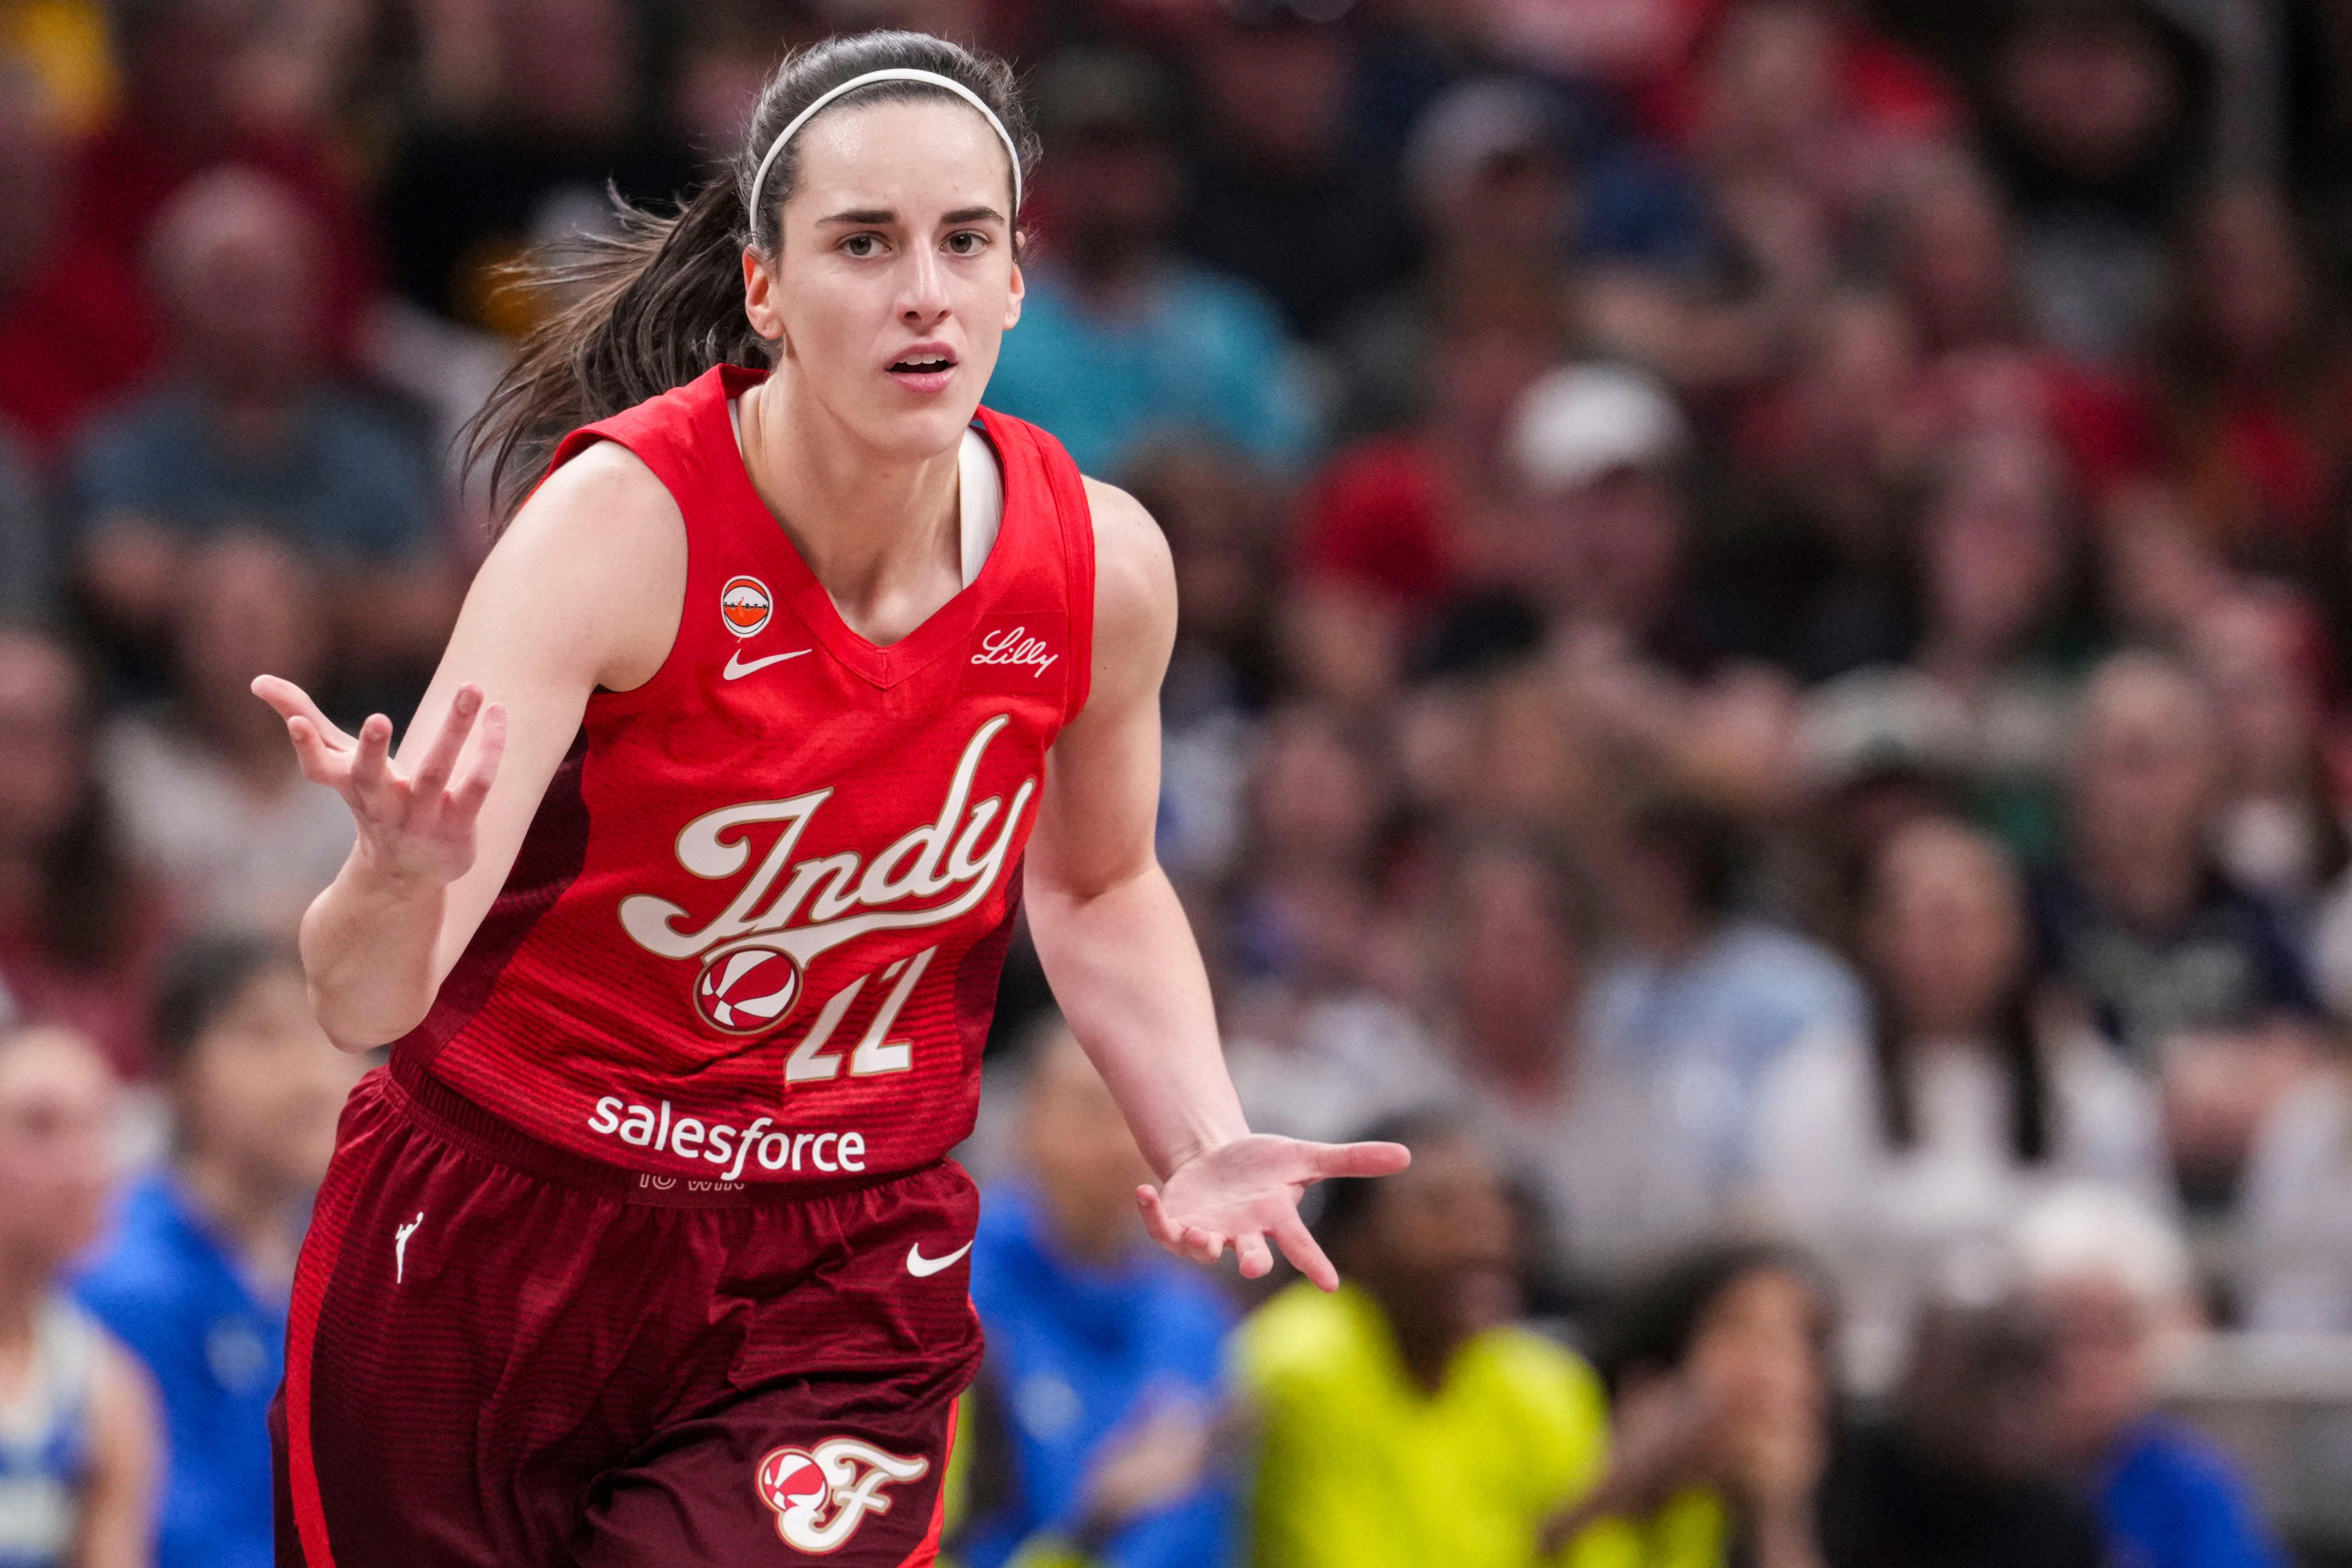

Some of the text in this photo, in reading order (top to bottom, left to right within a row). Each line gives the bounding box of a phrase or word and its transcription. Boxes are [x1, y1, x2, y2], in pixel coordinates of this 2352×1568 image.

[971, 626, 1058, 678] Lilly
[617, 713, 1037, 969] Indy
[784, 944, 938, 1083] 22
[588, 1096, 865, 1181] salesforce
